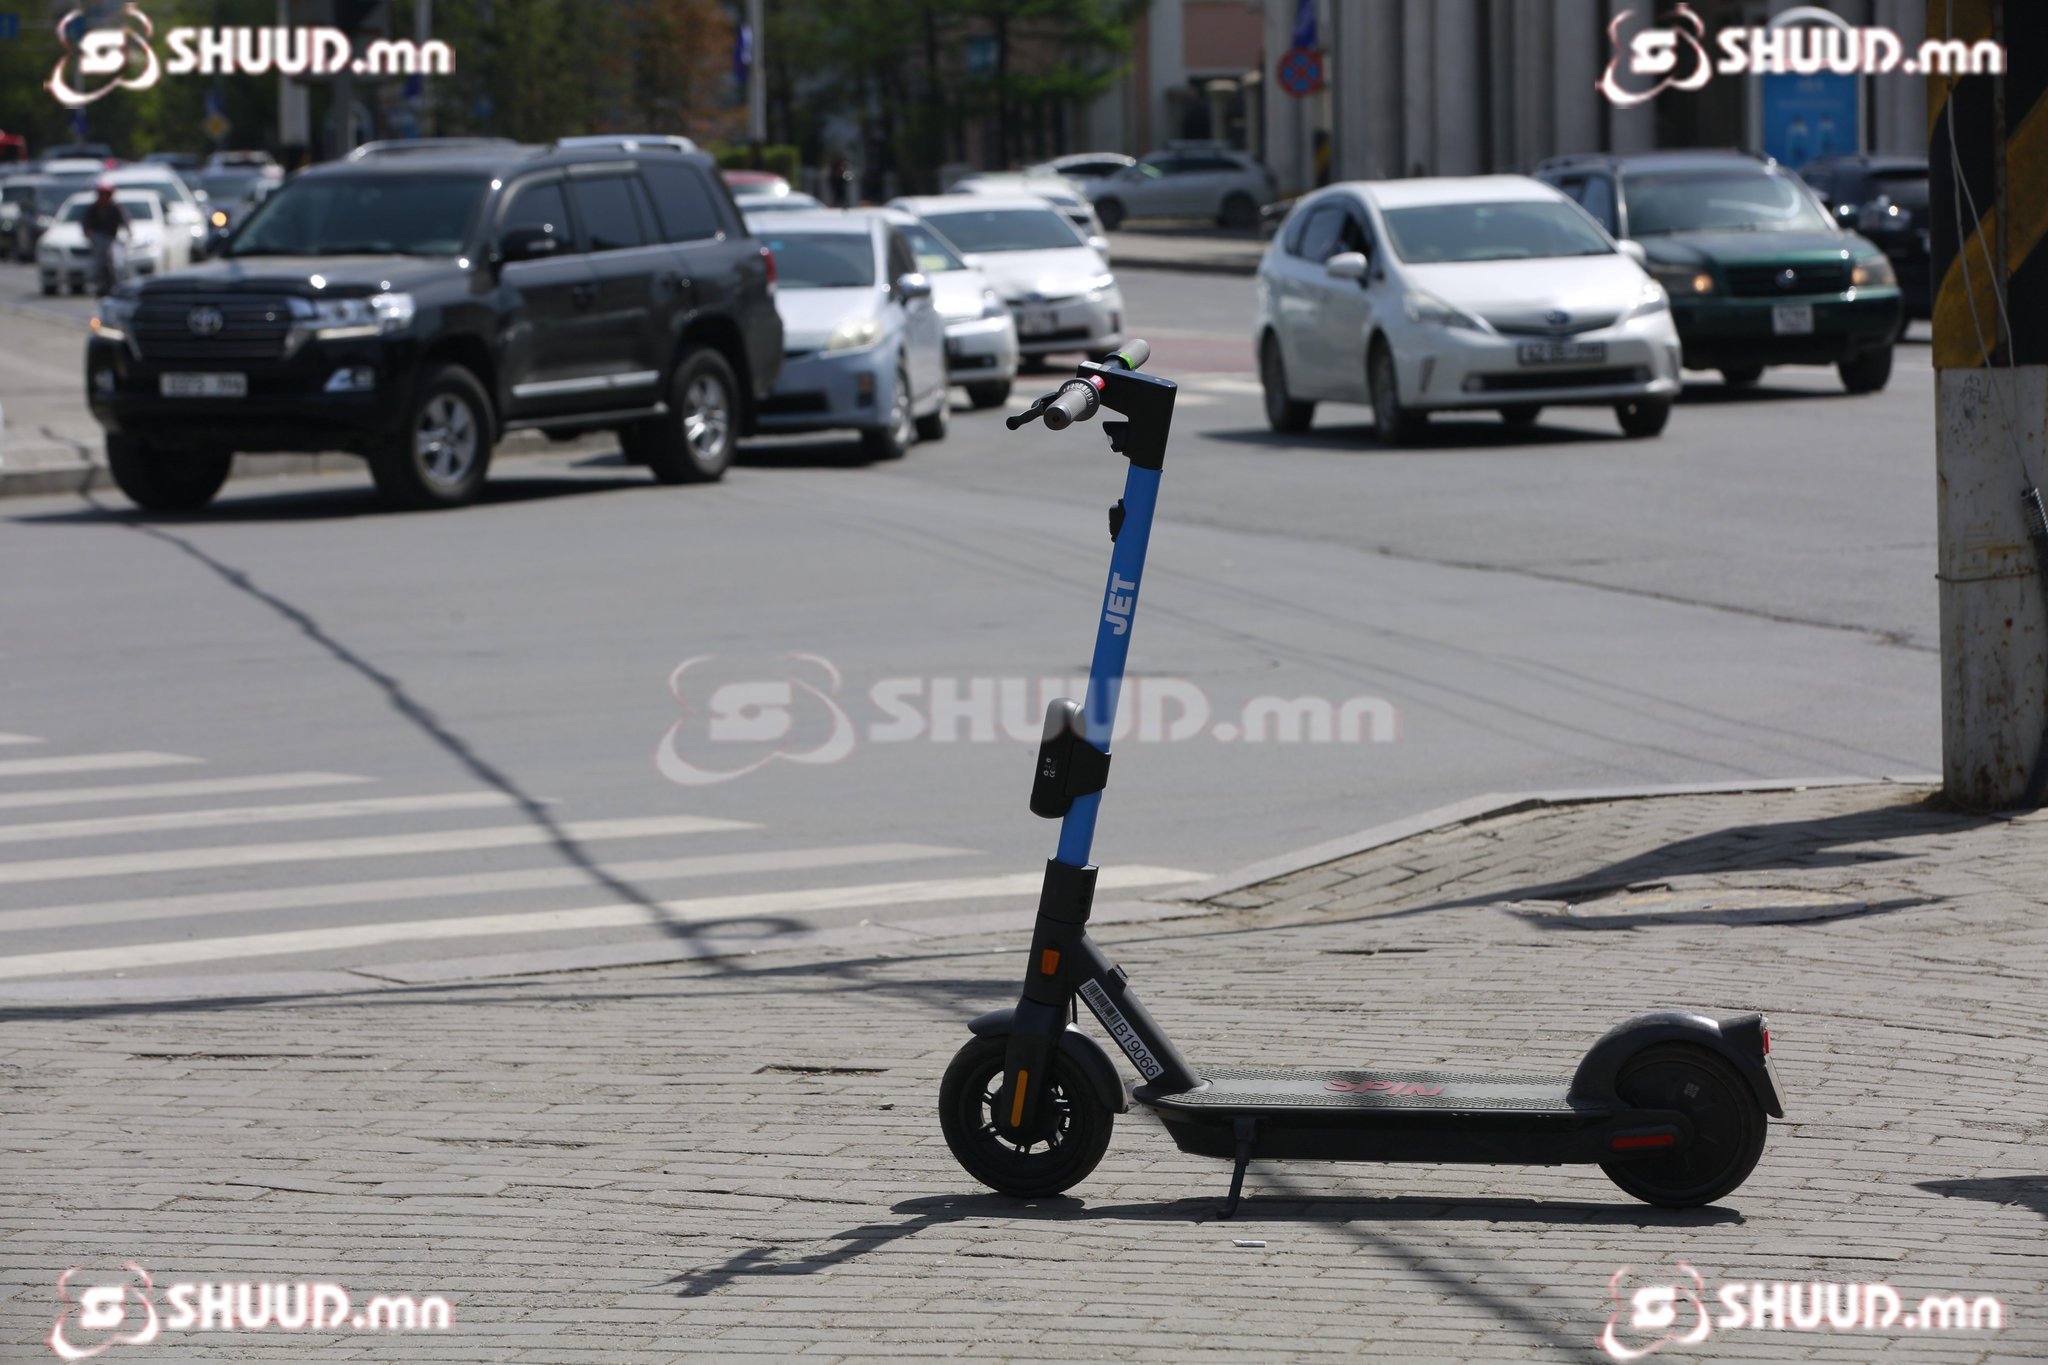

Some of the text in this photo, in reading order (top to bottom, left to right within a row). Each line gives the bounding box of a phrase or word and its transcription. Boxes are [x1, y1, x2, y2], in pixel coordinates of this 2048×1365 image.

[1105, 572, 1136, 635] JET
[1112, 1022, 1160, 1077] B19066
[1323, 1080, 1445, 1097] SPIN
